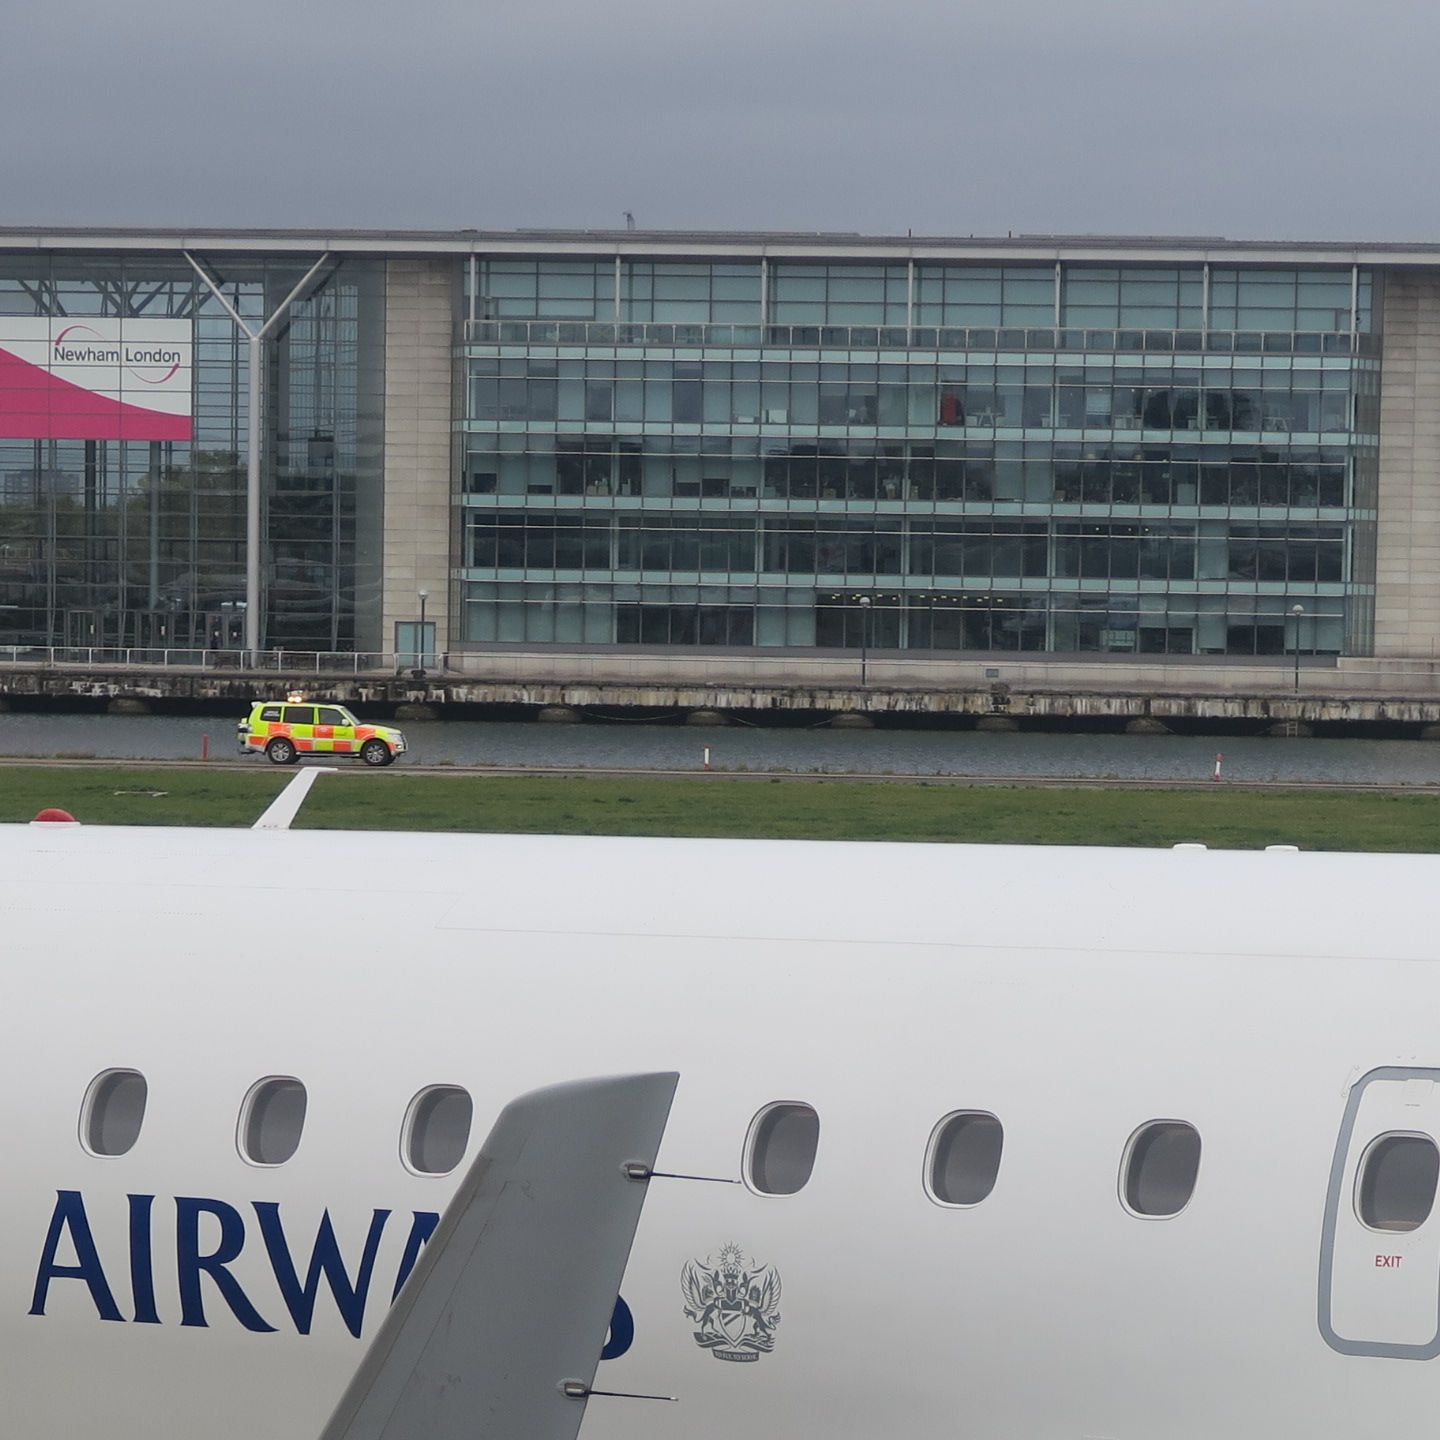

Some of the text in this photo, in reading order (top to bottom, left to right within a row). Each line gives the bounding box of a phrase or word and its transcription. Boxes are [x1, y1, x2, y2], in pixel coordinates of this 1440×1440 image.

[55, 346, 181, 363] Newham London
[1374, 1255, 1403, 1268] EXIT
